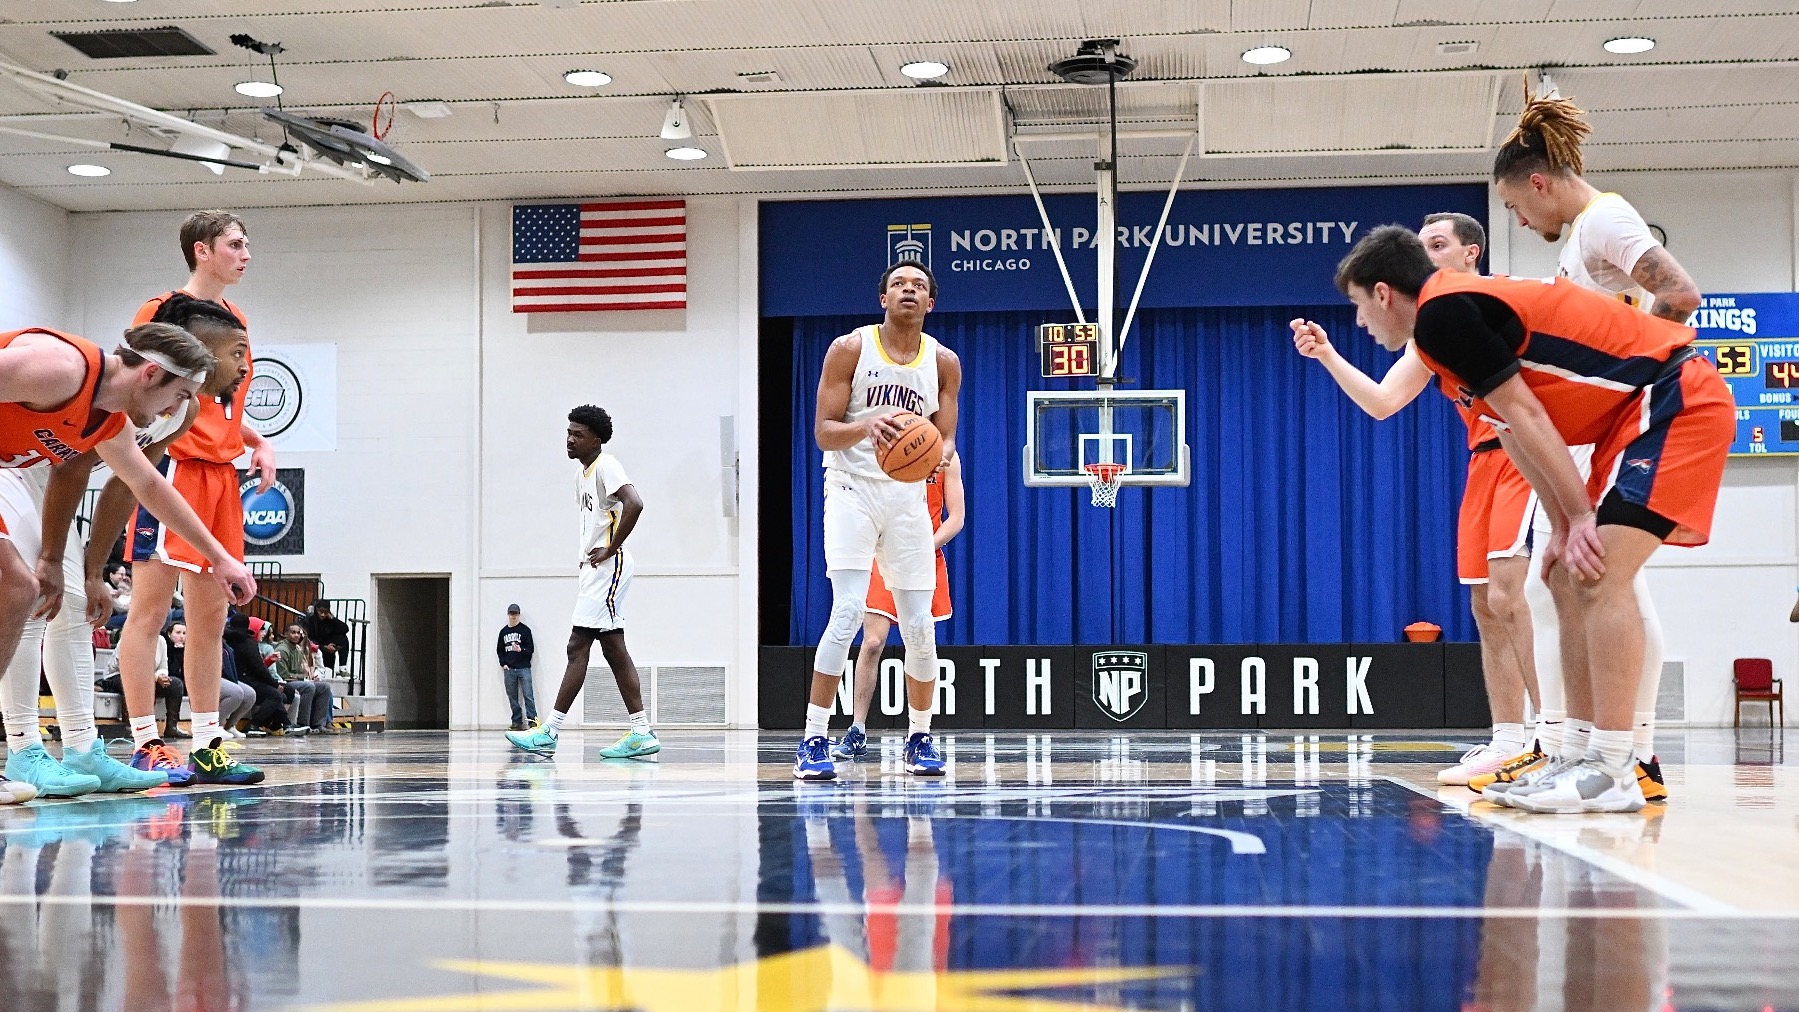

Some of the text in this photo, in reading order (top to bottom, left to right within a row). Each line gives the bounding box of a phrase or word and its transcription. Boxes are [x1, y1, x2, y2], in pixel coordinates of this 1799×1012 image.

[950, 228, 1061, 252] NORTH
[1165, 221, 1359, 247] UNIVERSITY
[951, 259, 1031, 271] CHICAGO
[1710, 298, 1736, 308] PARK
[1052, 345, 1089, 375] 30
[866, 384, 924, 417] VIKINGS
[1759, 393, 1792, 404] BONUS
[1753, 427, 1763, 442] 5
[1749, 442, 1768, 453] TOL
[243, 510, 287, 525] NCAA
[1098, 670, 1142, 715] NP
[1189, 657, 1375, 715] PARK
